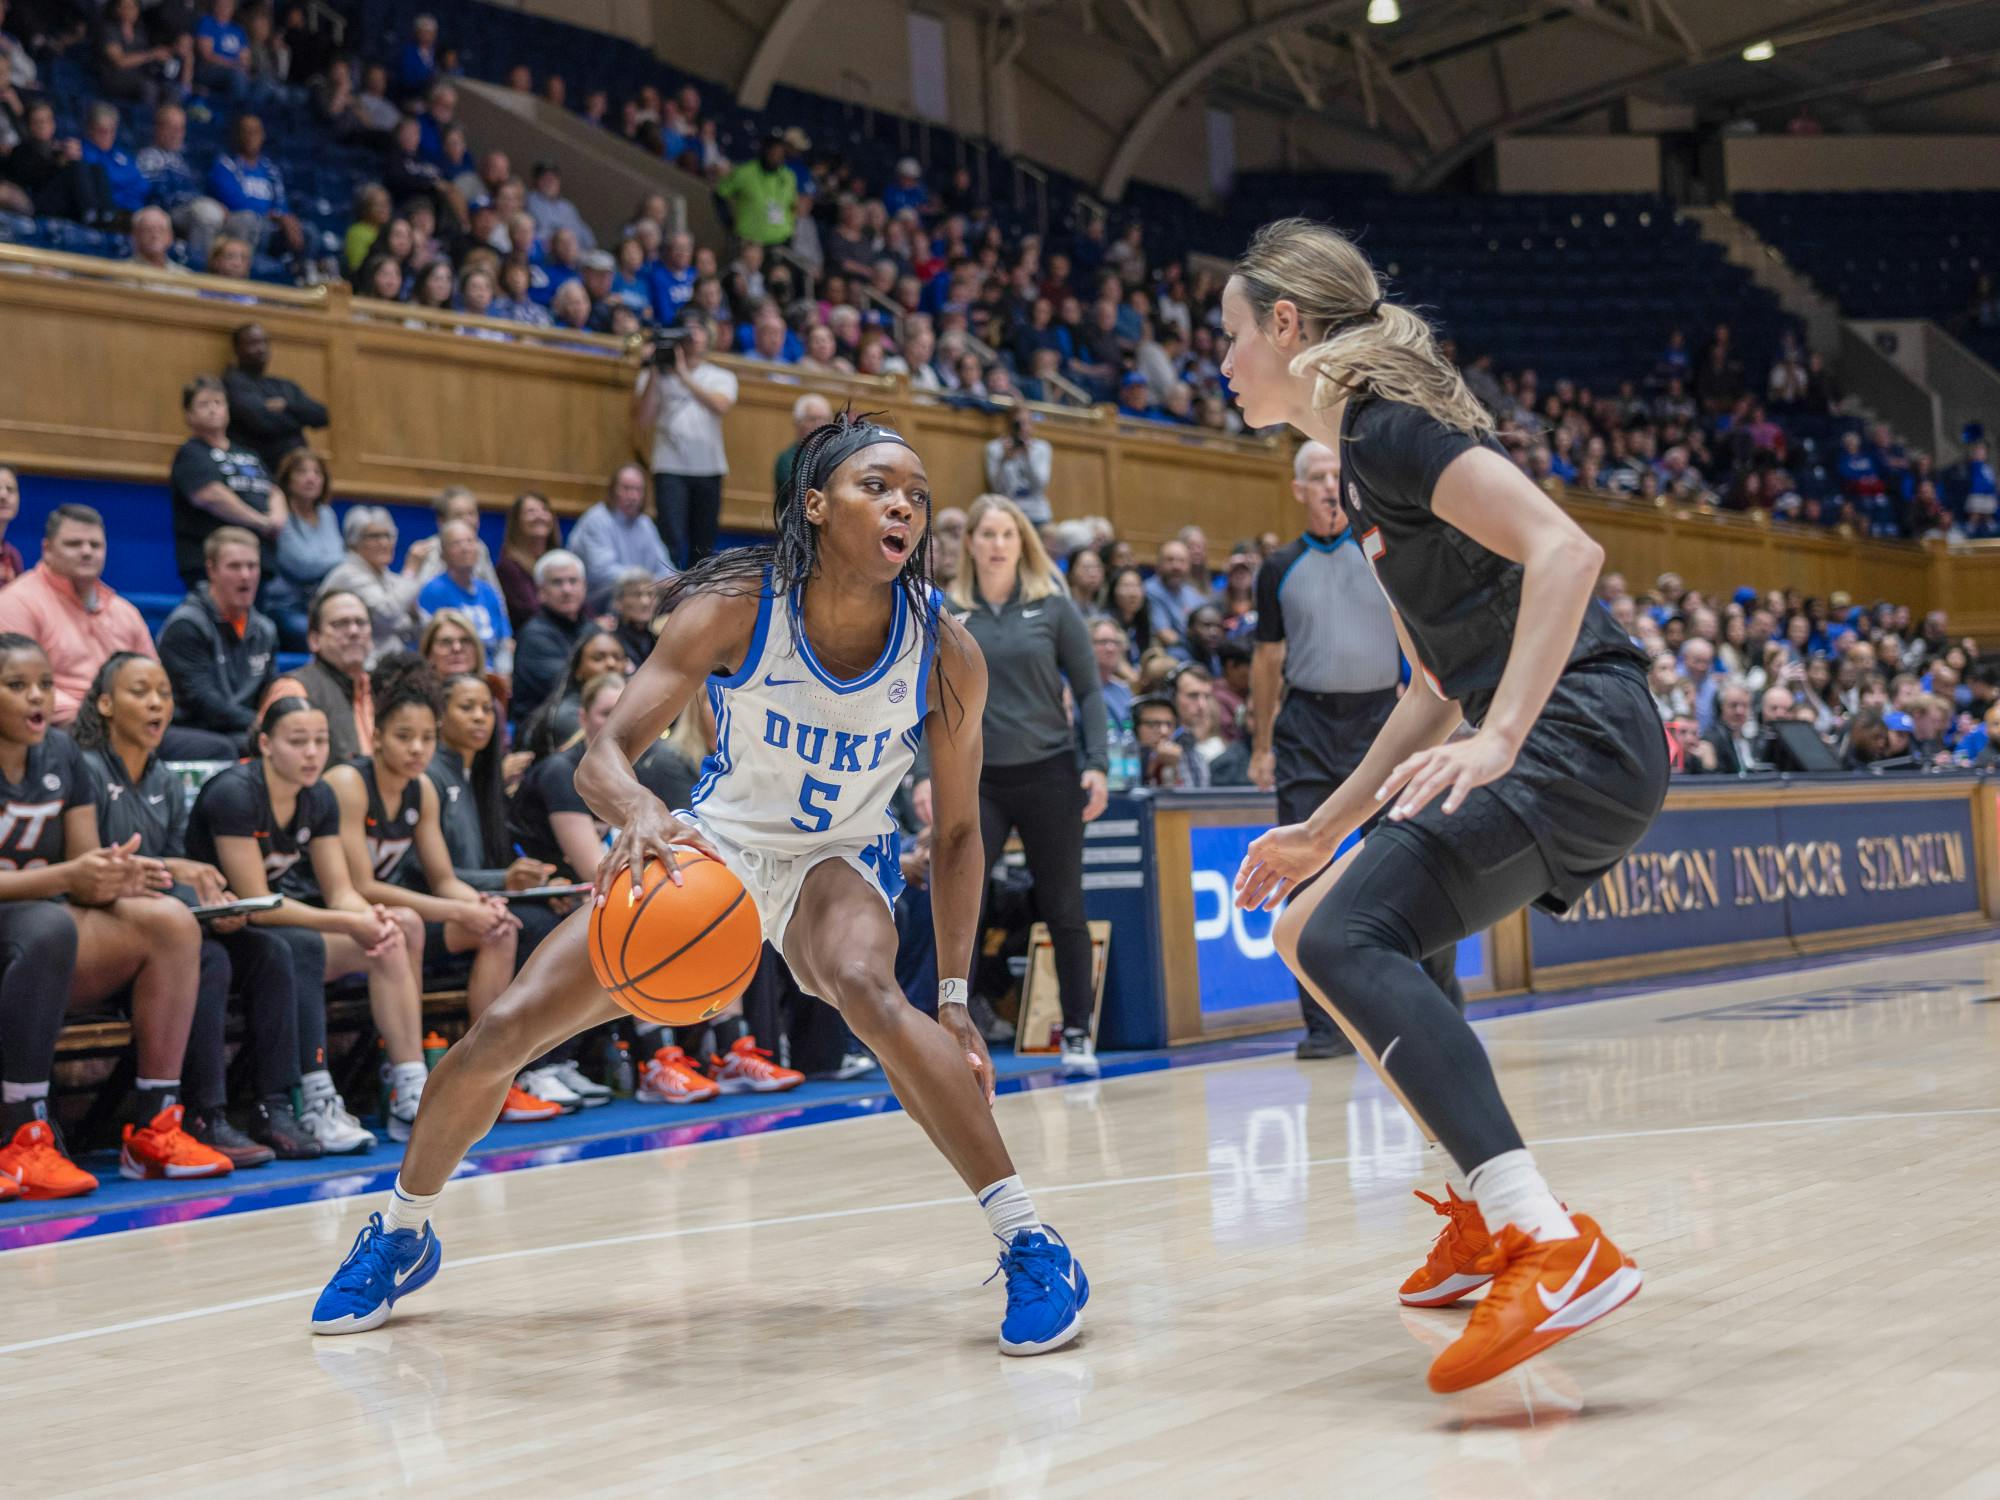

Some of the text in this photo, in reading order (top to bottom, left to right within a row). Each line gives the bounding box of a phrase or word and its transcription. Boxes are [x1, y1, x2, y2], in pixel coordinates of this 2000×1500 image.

[763, 708, 892, 773] DUKE
[790, 773, 842, 833] 5
[1553, 831, 1968, 922] AMERON INDOOR STADIUM
